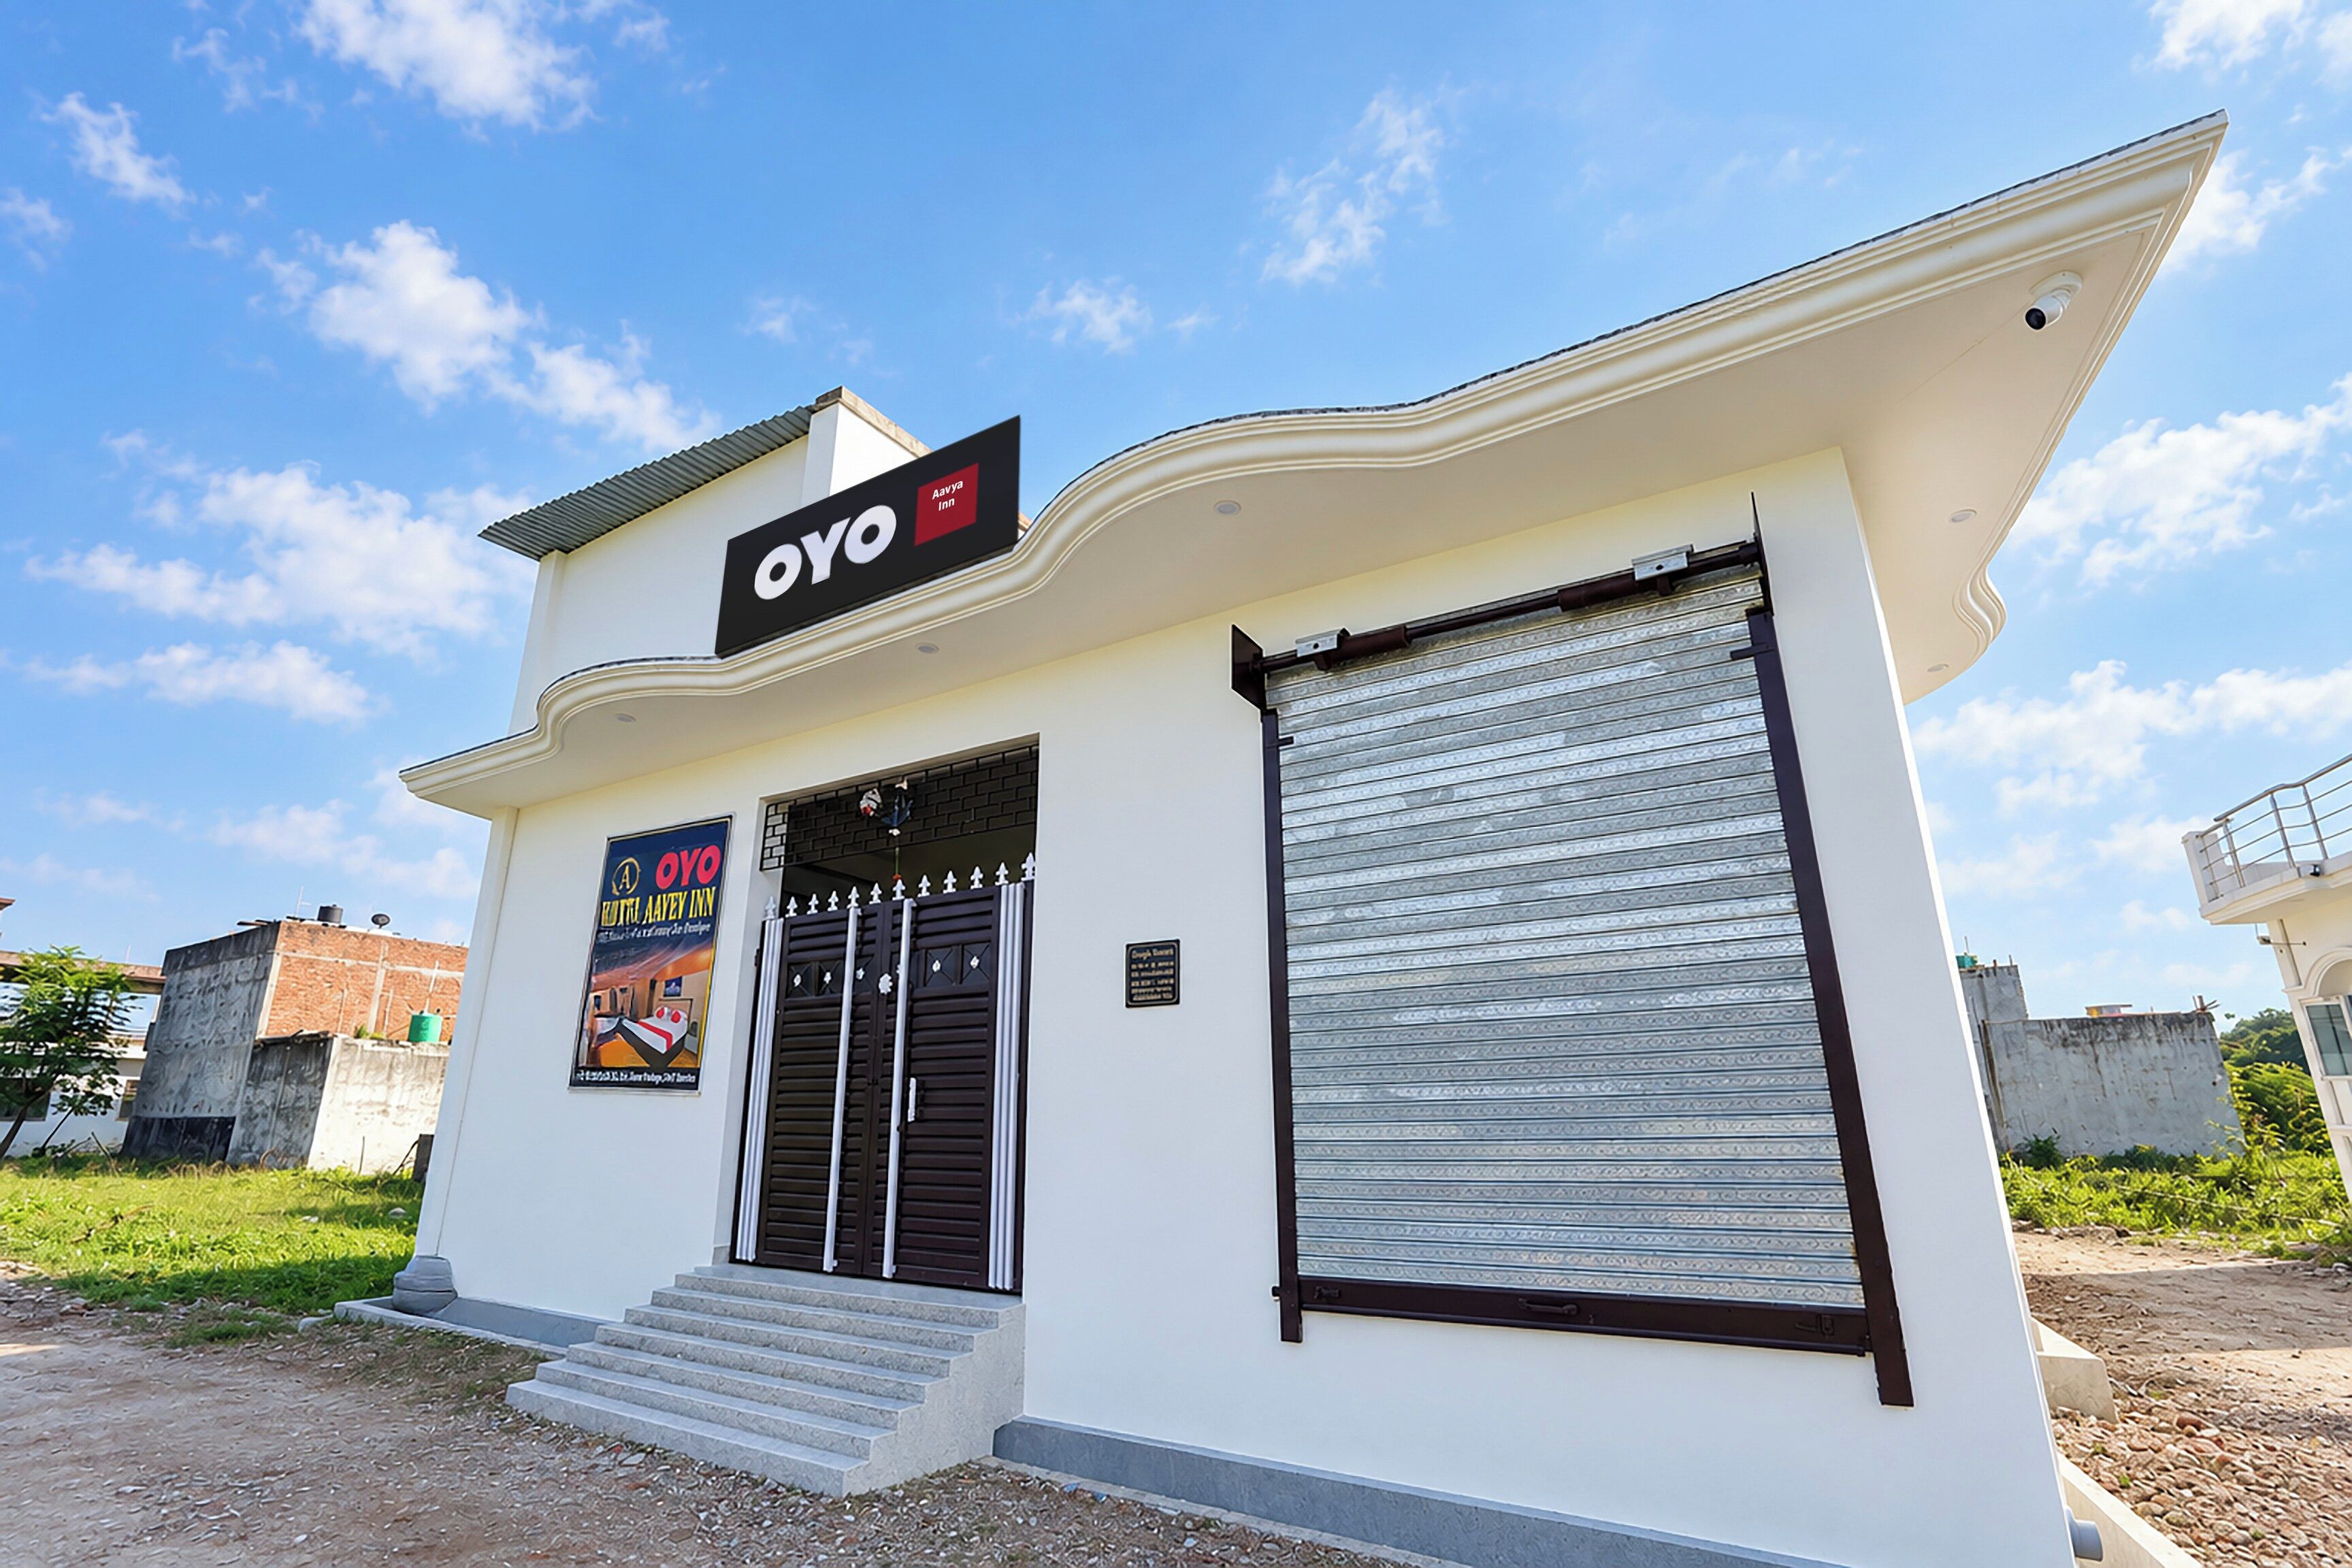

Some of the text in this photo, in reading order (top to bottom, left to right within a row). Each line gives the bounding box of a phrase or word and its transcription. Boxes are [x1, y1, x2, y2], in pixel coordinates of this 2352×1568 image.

[932, 480, 964, 500] Aavya
[938, 497, 955, 512] Inn
[754, 504, 897, 600] OYO
[655, 845, 721, 889] OYO
[689, 886, 716, 919] INN
